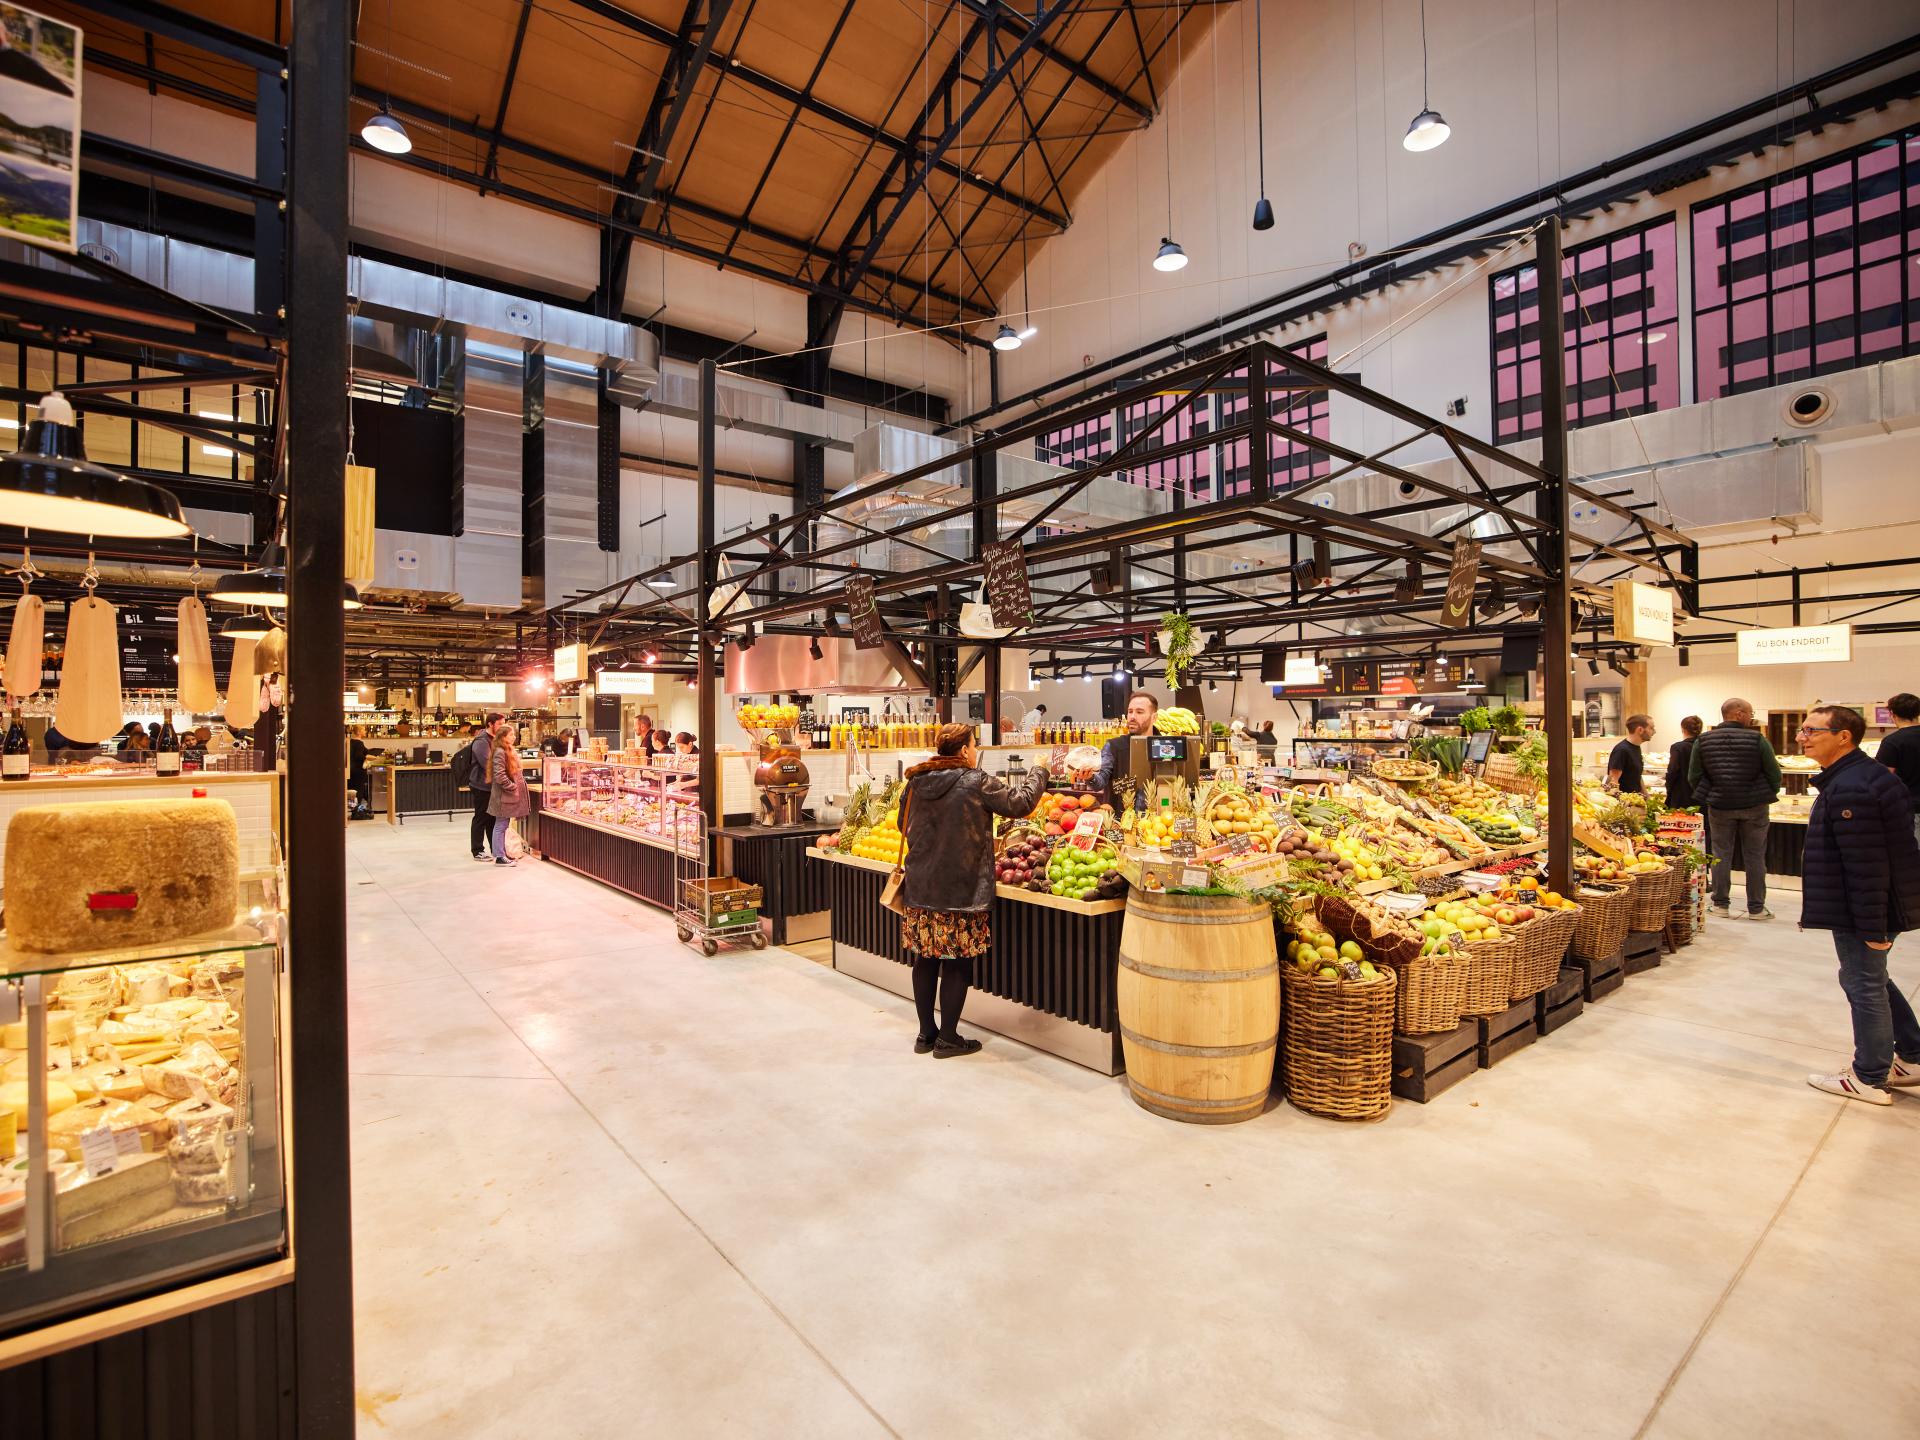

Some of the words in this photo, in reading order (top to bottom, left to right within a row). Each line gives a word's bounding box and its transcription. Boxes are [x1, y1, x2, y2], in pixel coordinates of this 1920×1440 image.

[1756, 639, 1769, 648] AU
[1770, 638, 1789, 648] BON
[1791, 636, 1831, 647] ENDROIT
